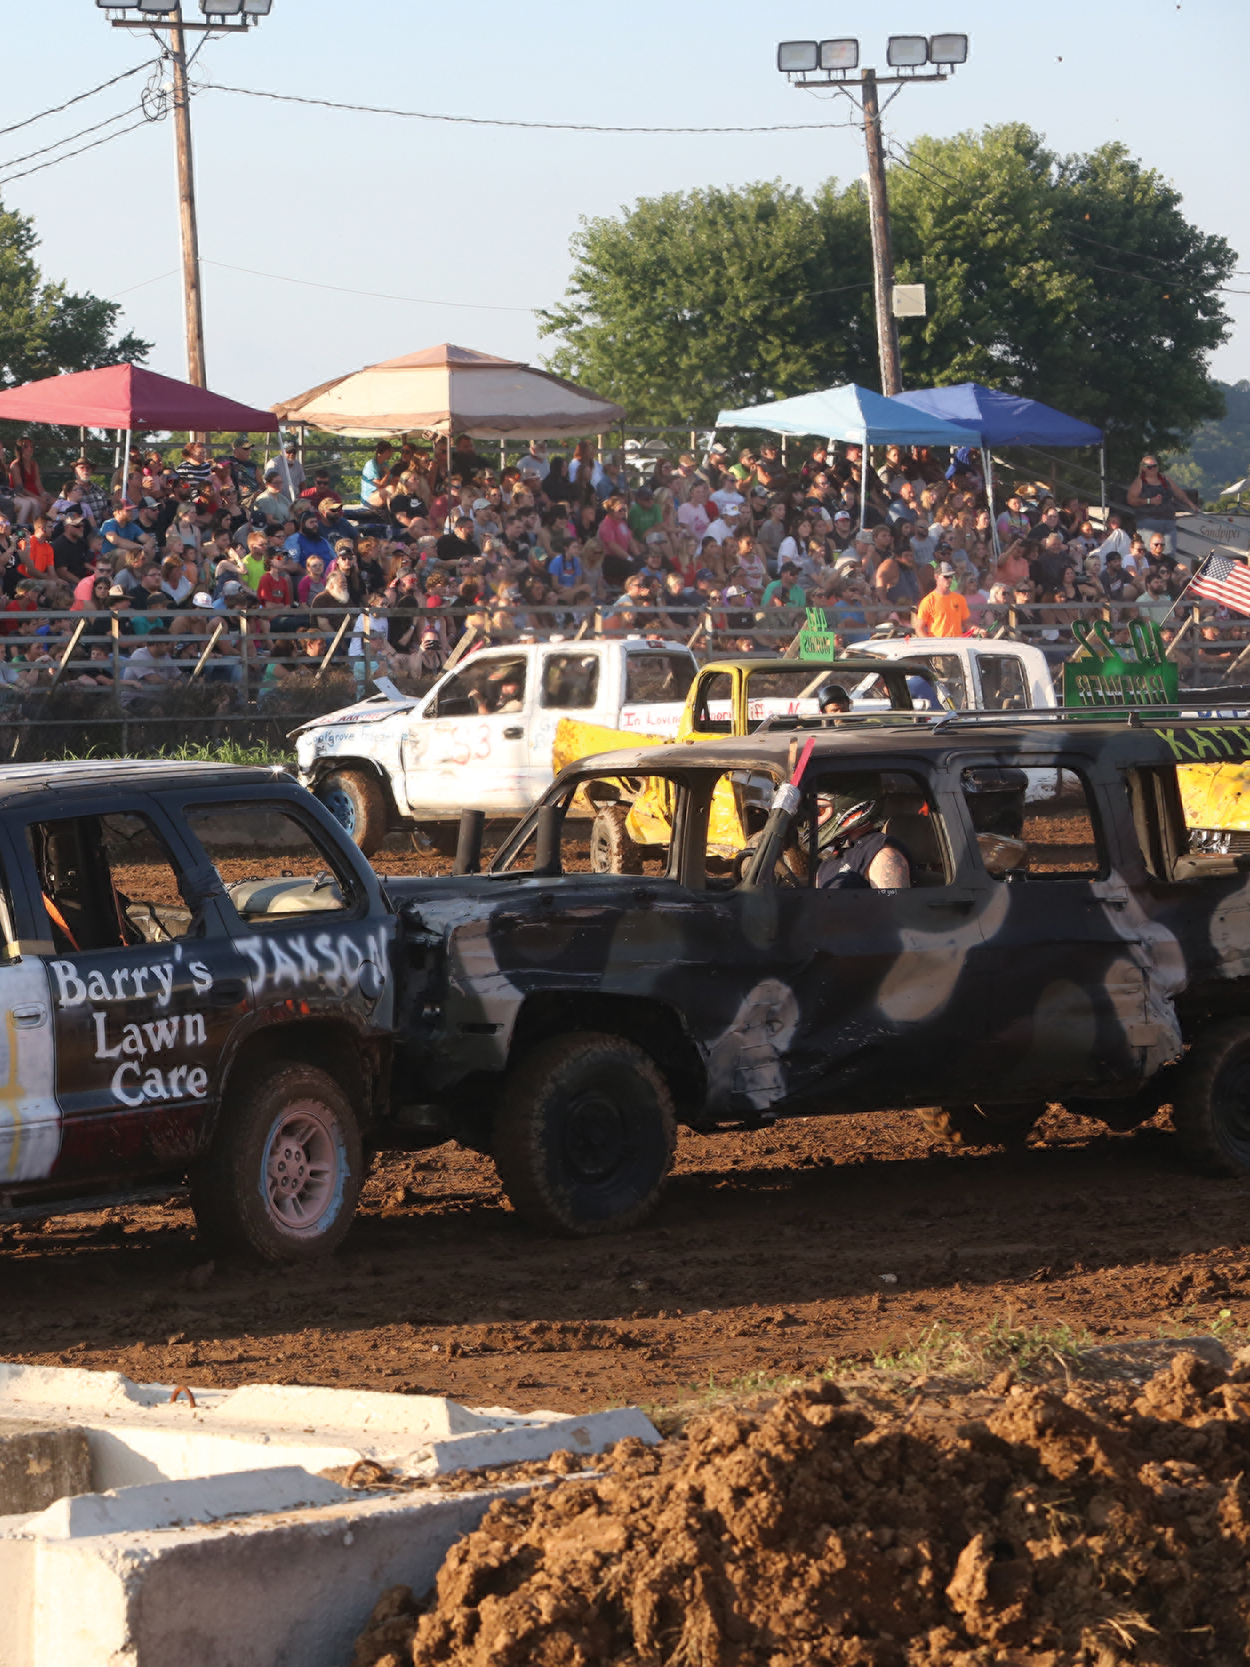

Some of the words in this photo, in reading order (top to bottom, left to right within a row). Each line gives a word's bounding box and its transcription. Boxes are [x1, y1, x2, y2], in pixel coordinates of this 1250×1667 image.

[1199, 525, 1240, 542] Sandpiper
[623, 712, 641, 727] In
[50, 943, 214, 1008] Barry's
[232, 926, 388, 993] JAXSON
[92, 1011, 208, 1062] Lawn
[111, 1060, 209, 1107] Care
